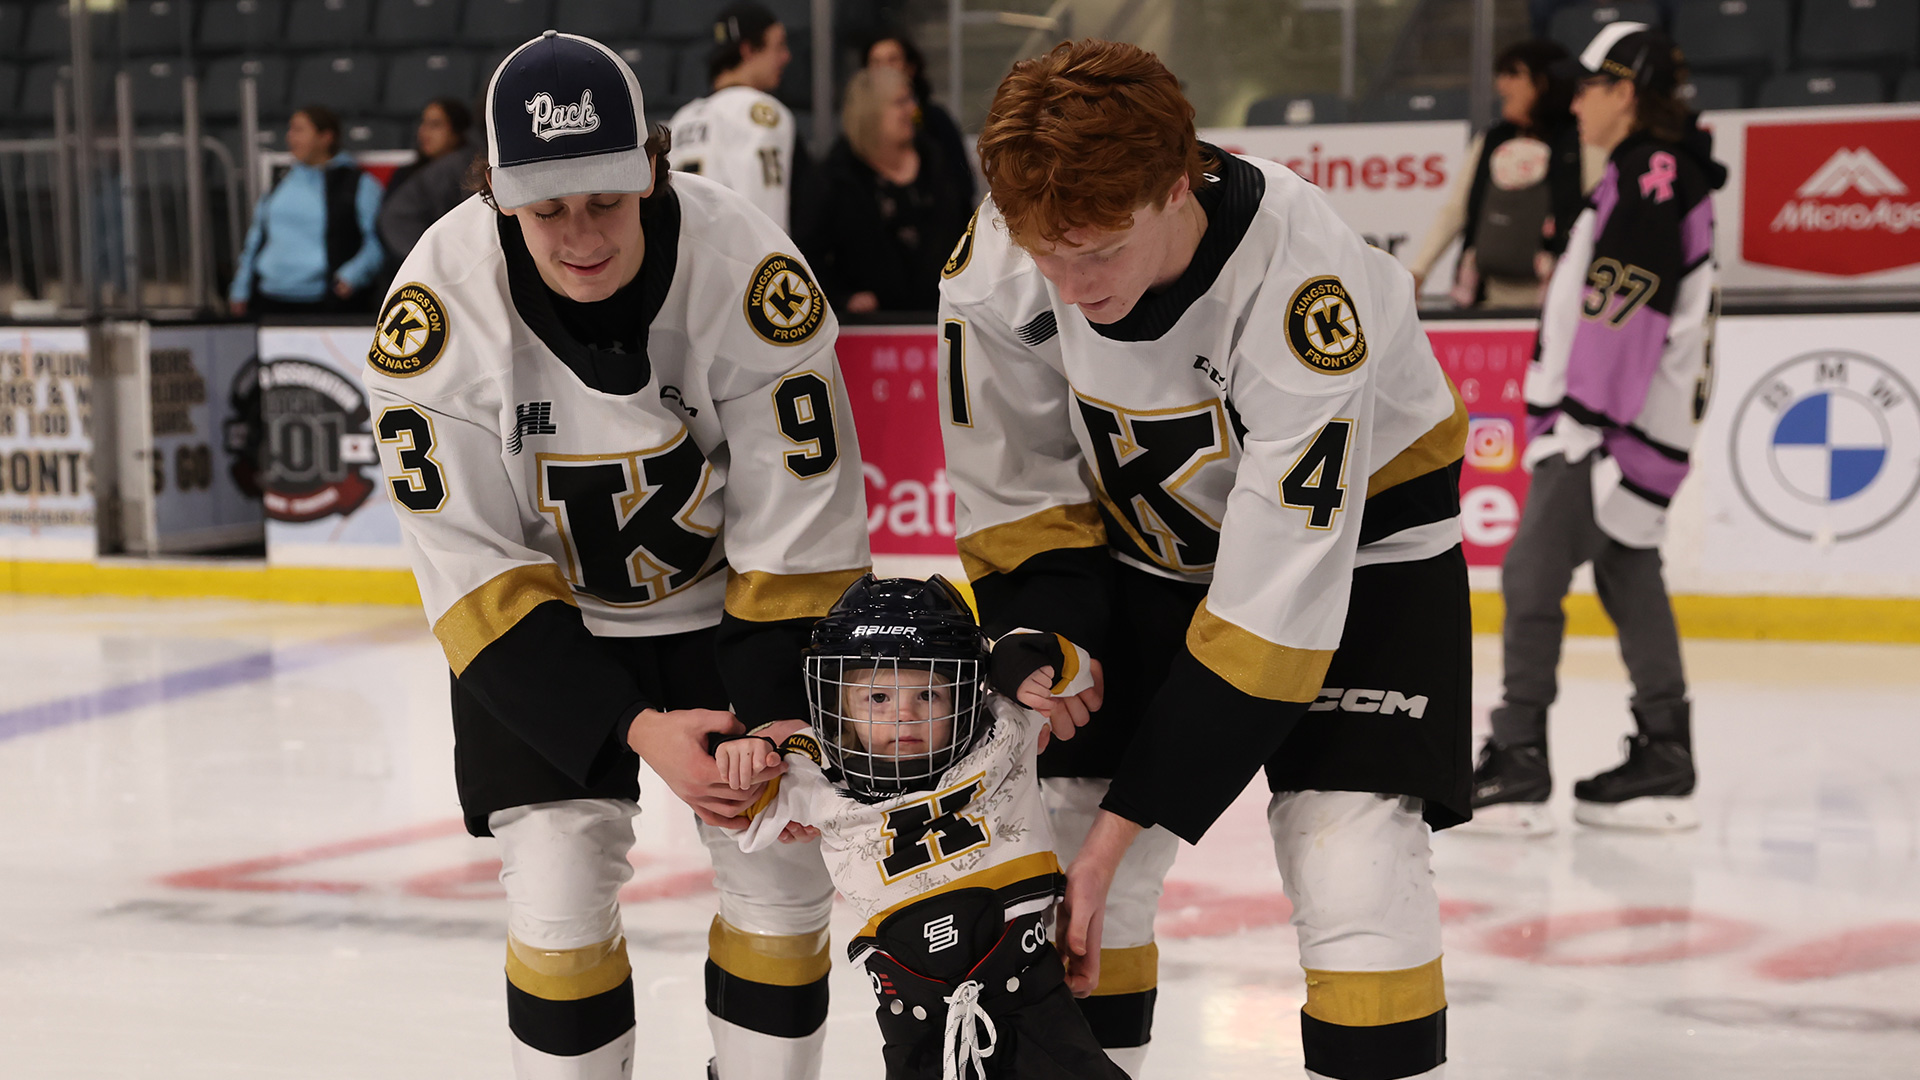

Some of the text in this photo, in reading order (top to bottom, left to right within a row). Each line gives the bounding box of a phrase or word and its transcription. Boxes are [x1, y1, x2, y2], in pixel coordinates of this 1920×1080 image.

[525, 89, 600, 142] Pack
[1220, 141, 1448, 190] siness
[751, 260, 787, 306] KINGSTON
[767, 273, 811, 323] K
[1294, 284, 1346, 316] KINGSTON
[1582, 256, 1660, 330] 37
[382, 303, 428, 354] K
[401, 289, 441, 331] KINGSTON
[772, 281, 822, 339] FRONTENACS
[1309, 301, 1355, 349] K
[371, 322, 421, 370] TENACS
[1305, 327, 1365, 368] FRONTENAC
[1192, 354, 1227, 391] CC
[770, 369, 840, 480] 9
[0, 449, 98, 496] ONT
[377, 404, 450, 514] 3
[1071, 394, 1229, 573] K
[1278, 418, 1354, 531] 4
[535, 424, 726, 609] K
[1308, 688, 1429, 719] CCM
[876, 771, 991, 886] K
[1021, 917, 1046, 954] CO
